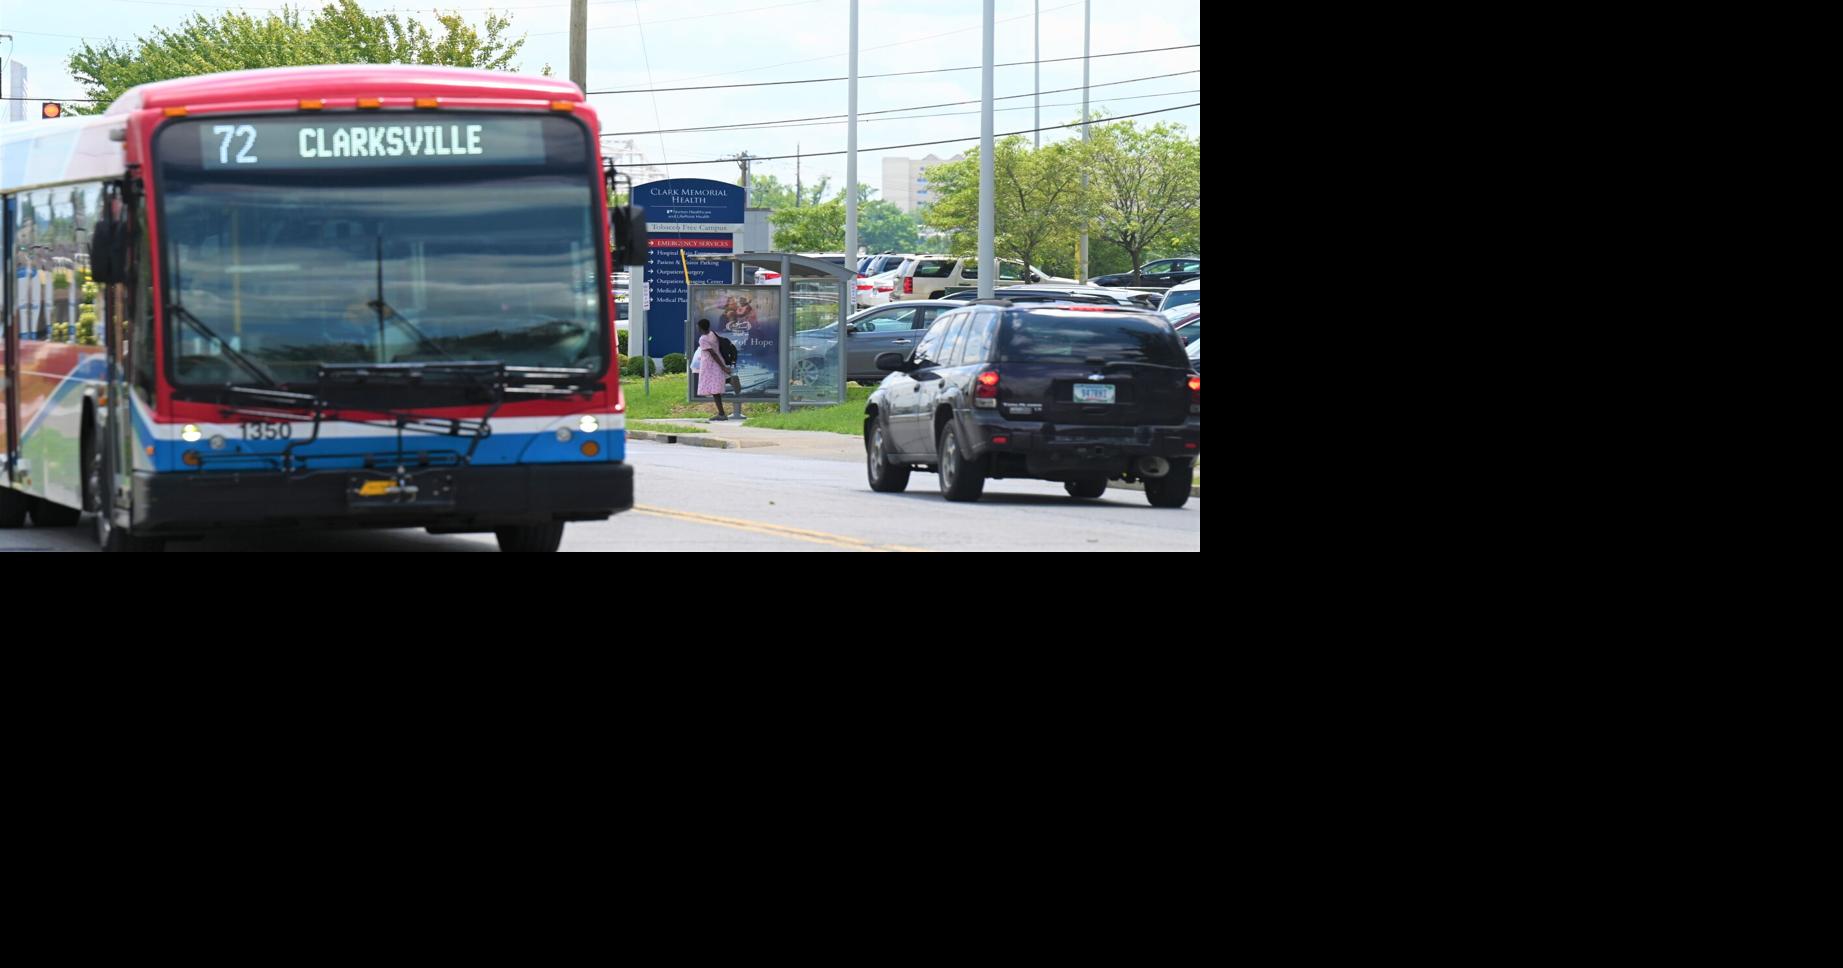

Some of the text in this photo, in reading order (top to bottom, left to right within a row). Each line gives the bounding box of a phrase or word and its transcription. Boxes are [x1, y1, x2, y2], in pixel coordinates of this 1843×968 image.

[213, 125, 483, 164] 72 CLARKSVILLE
[650, 187, 727, 197] CLARK MEMORIAL
[672, 196, 706, 204] HEALTH
[652, 223, 728, 232] Tobacco Free Campus
[700, 259, 719, 267] Parking
[751, 337, 774, 348] Hope
[240, 421, 292, 441] 1350
